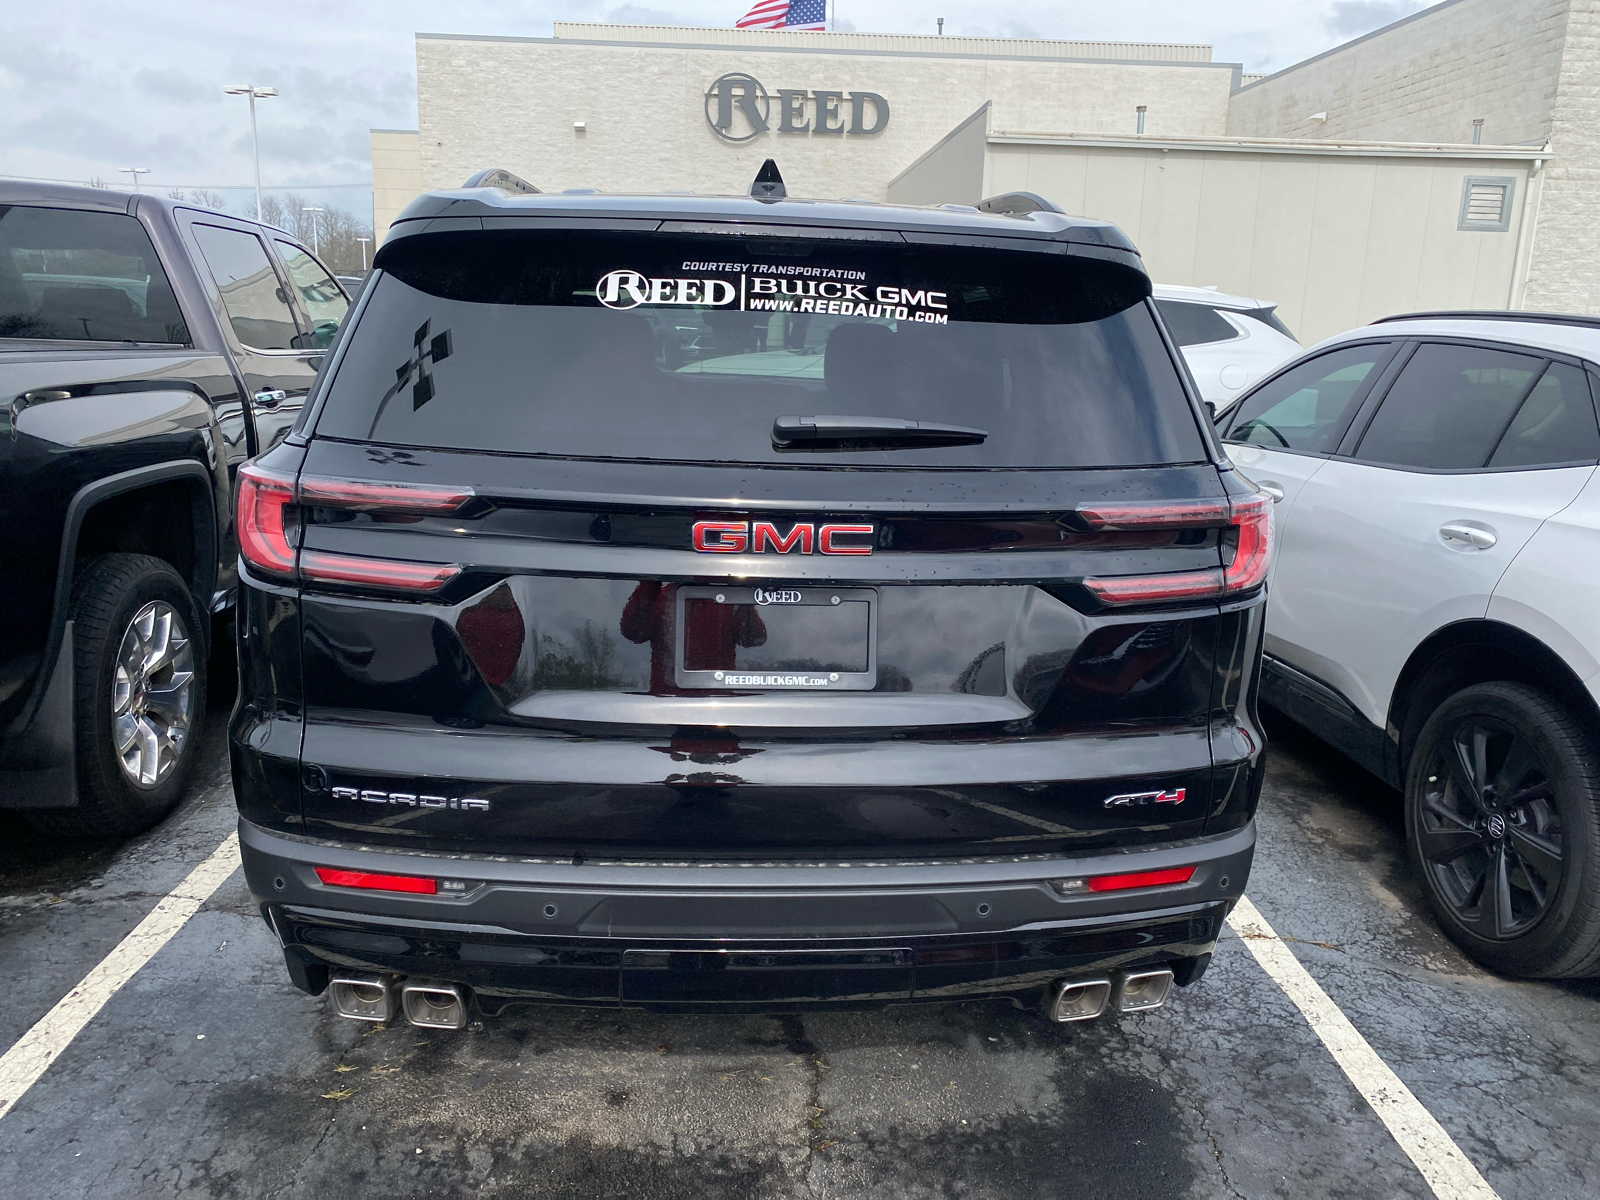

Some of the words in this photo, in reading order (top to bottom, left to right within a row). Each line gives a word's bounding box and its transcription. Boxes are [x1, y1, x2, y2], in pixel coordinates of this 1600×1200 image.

[704, 72, 890, 142] REED
[681, 260, 750, 272] COURTESY
[751, 263, 867, 281] TRANSPORTATION
[596, 269, 736, 310] REED
[750, 277, 870, 301] BUICK
[876, 286, 948, 309] GMC
[749, 298, 949, 325] WWW.REEDAUTO.COM
[692, 520, 875, 556] GMC
[754, 587, 802, 606] REED
[724, 675, 829, 687] REEDBUICKGMC.COM
[331, 786, 491, 813] ACADIA
[1103, 787, 1187, 809] AT4
